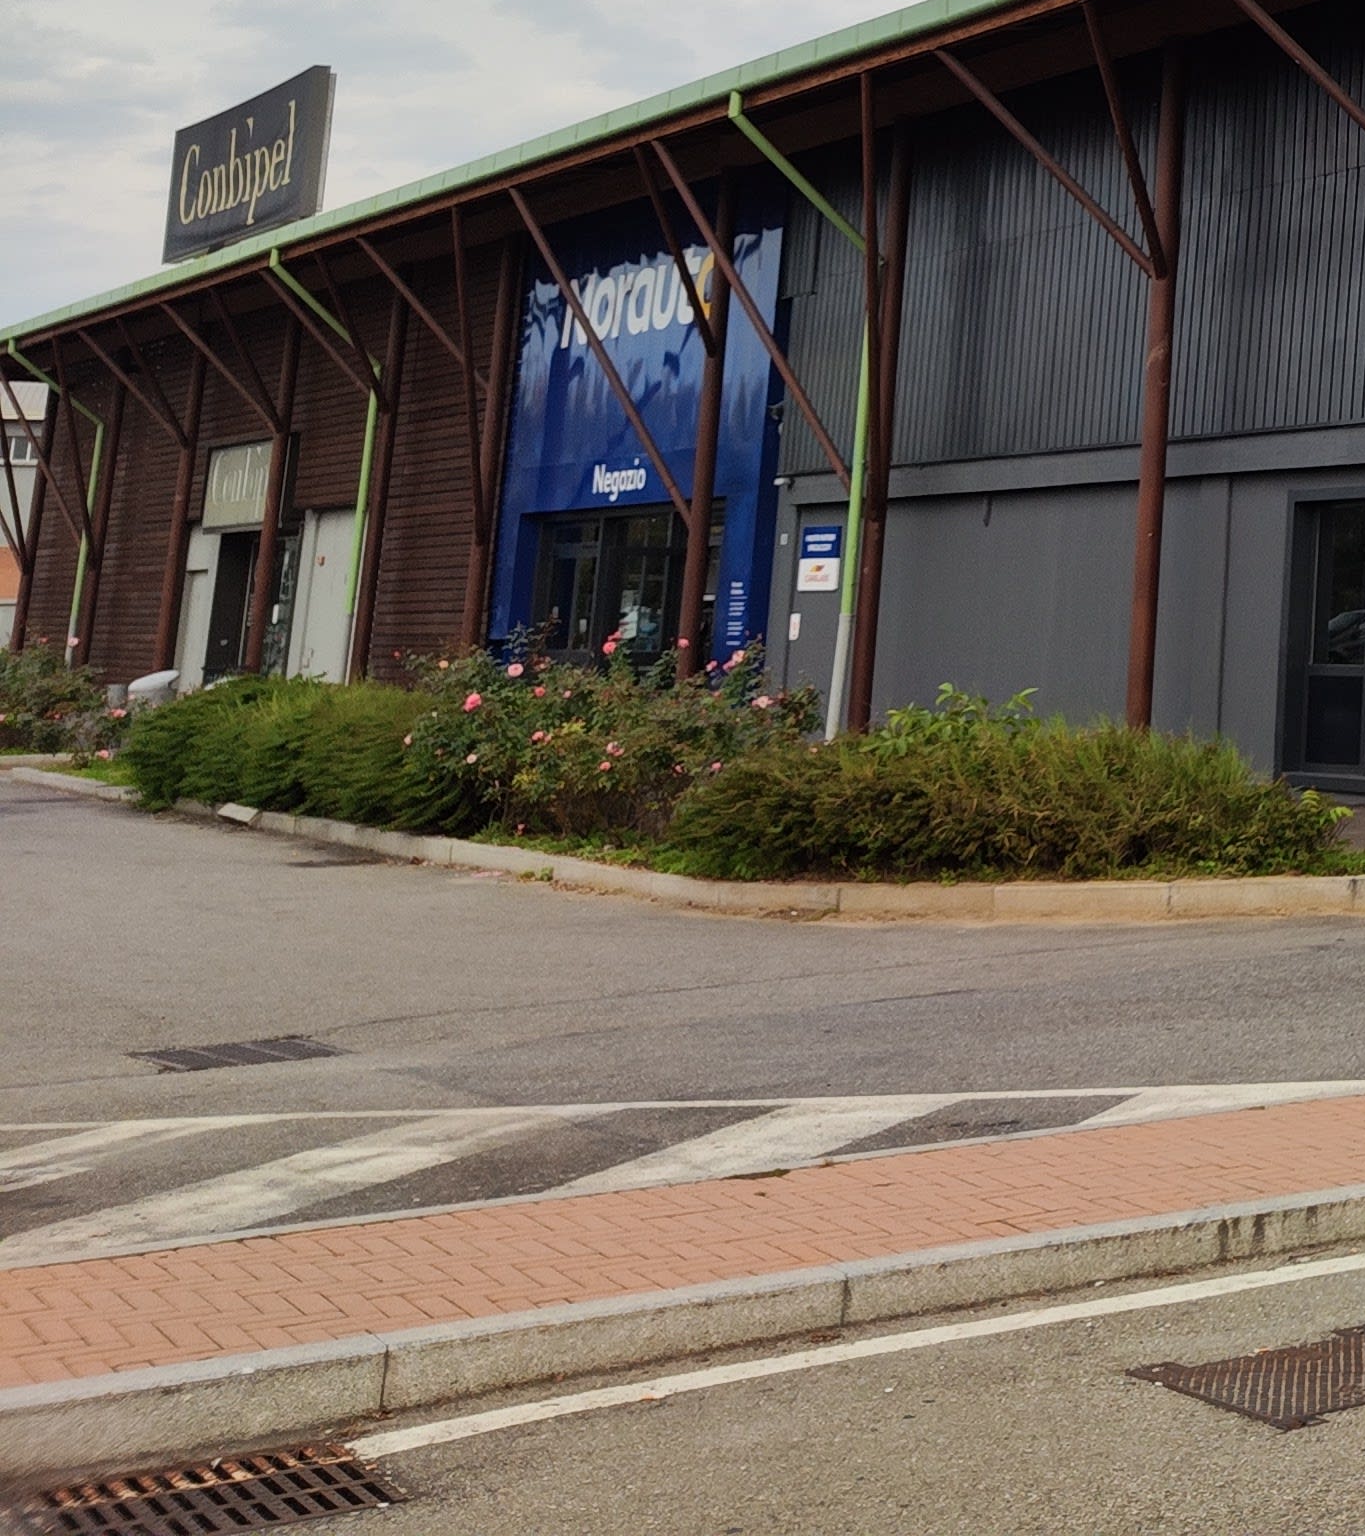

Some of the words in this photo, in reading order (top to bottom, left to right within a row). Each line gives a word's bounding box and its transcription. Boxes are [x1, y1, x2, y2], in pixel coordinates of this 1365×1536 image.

[179, 99, 296, 226] Conbipel
[212, 448, 269, 518] Conbip
[592, 457, 647, 502] Negozio
